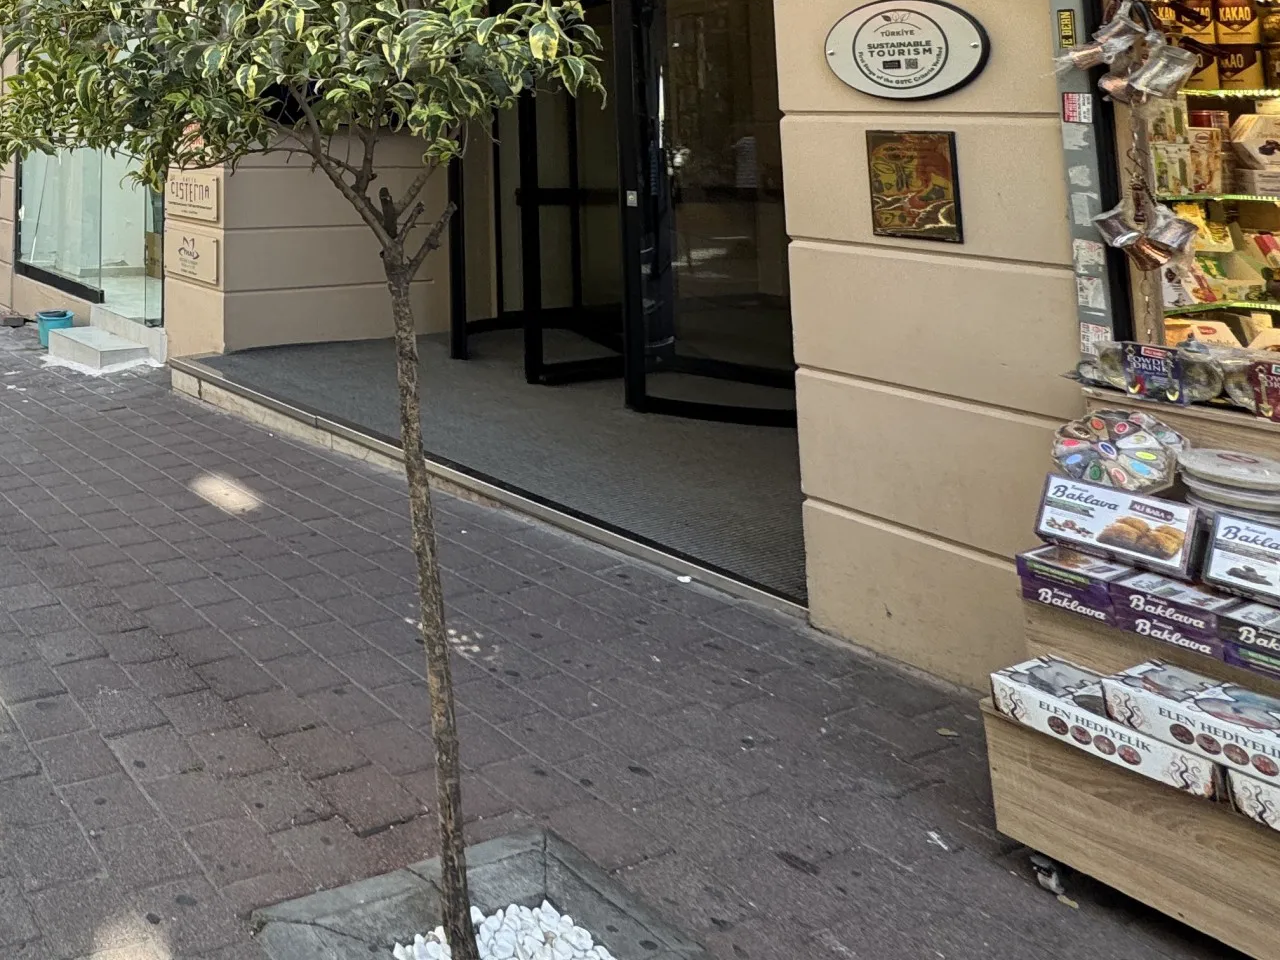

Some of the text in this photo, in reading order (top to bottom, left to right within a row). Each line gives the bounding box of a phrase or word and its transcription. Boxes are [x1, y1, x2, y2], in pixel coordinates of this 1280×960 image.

[1219, 6, 1252, 22] KAKAO
[867, 40, 932, 50] SUSTAINABLE
[880, 28, 915, 38] TÜRKİYE
[868, 47, 933, 58] TOURISM
[1052, 483, 1120, 512] Baklava
[1038, 588, 1106, 620] Baklava
[1129, 594, 1206, 630] Baklava
[1135, 618, 1213, 655] Baklava
[1038, 700, 1152, 754] ELEN HEDİYELİK
[1158, 706, 1197, 730] ELEN
